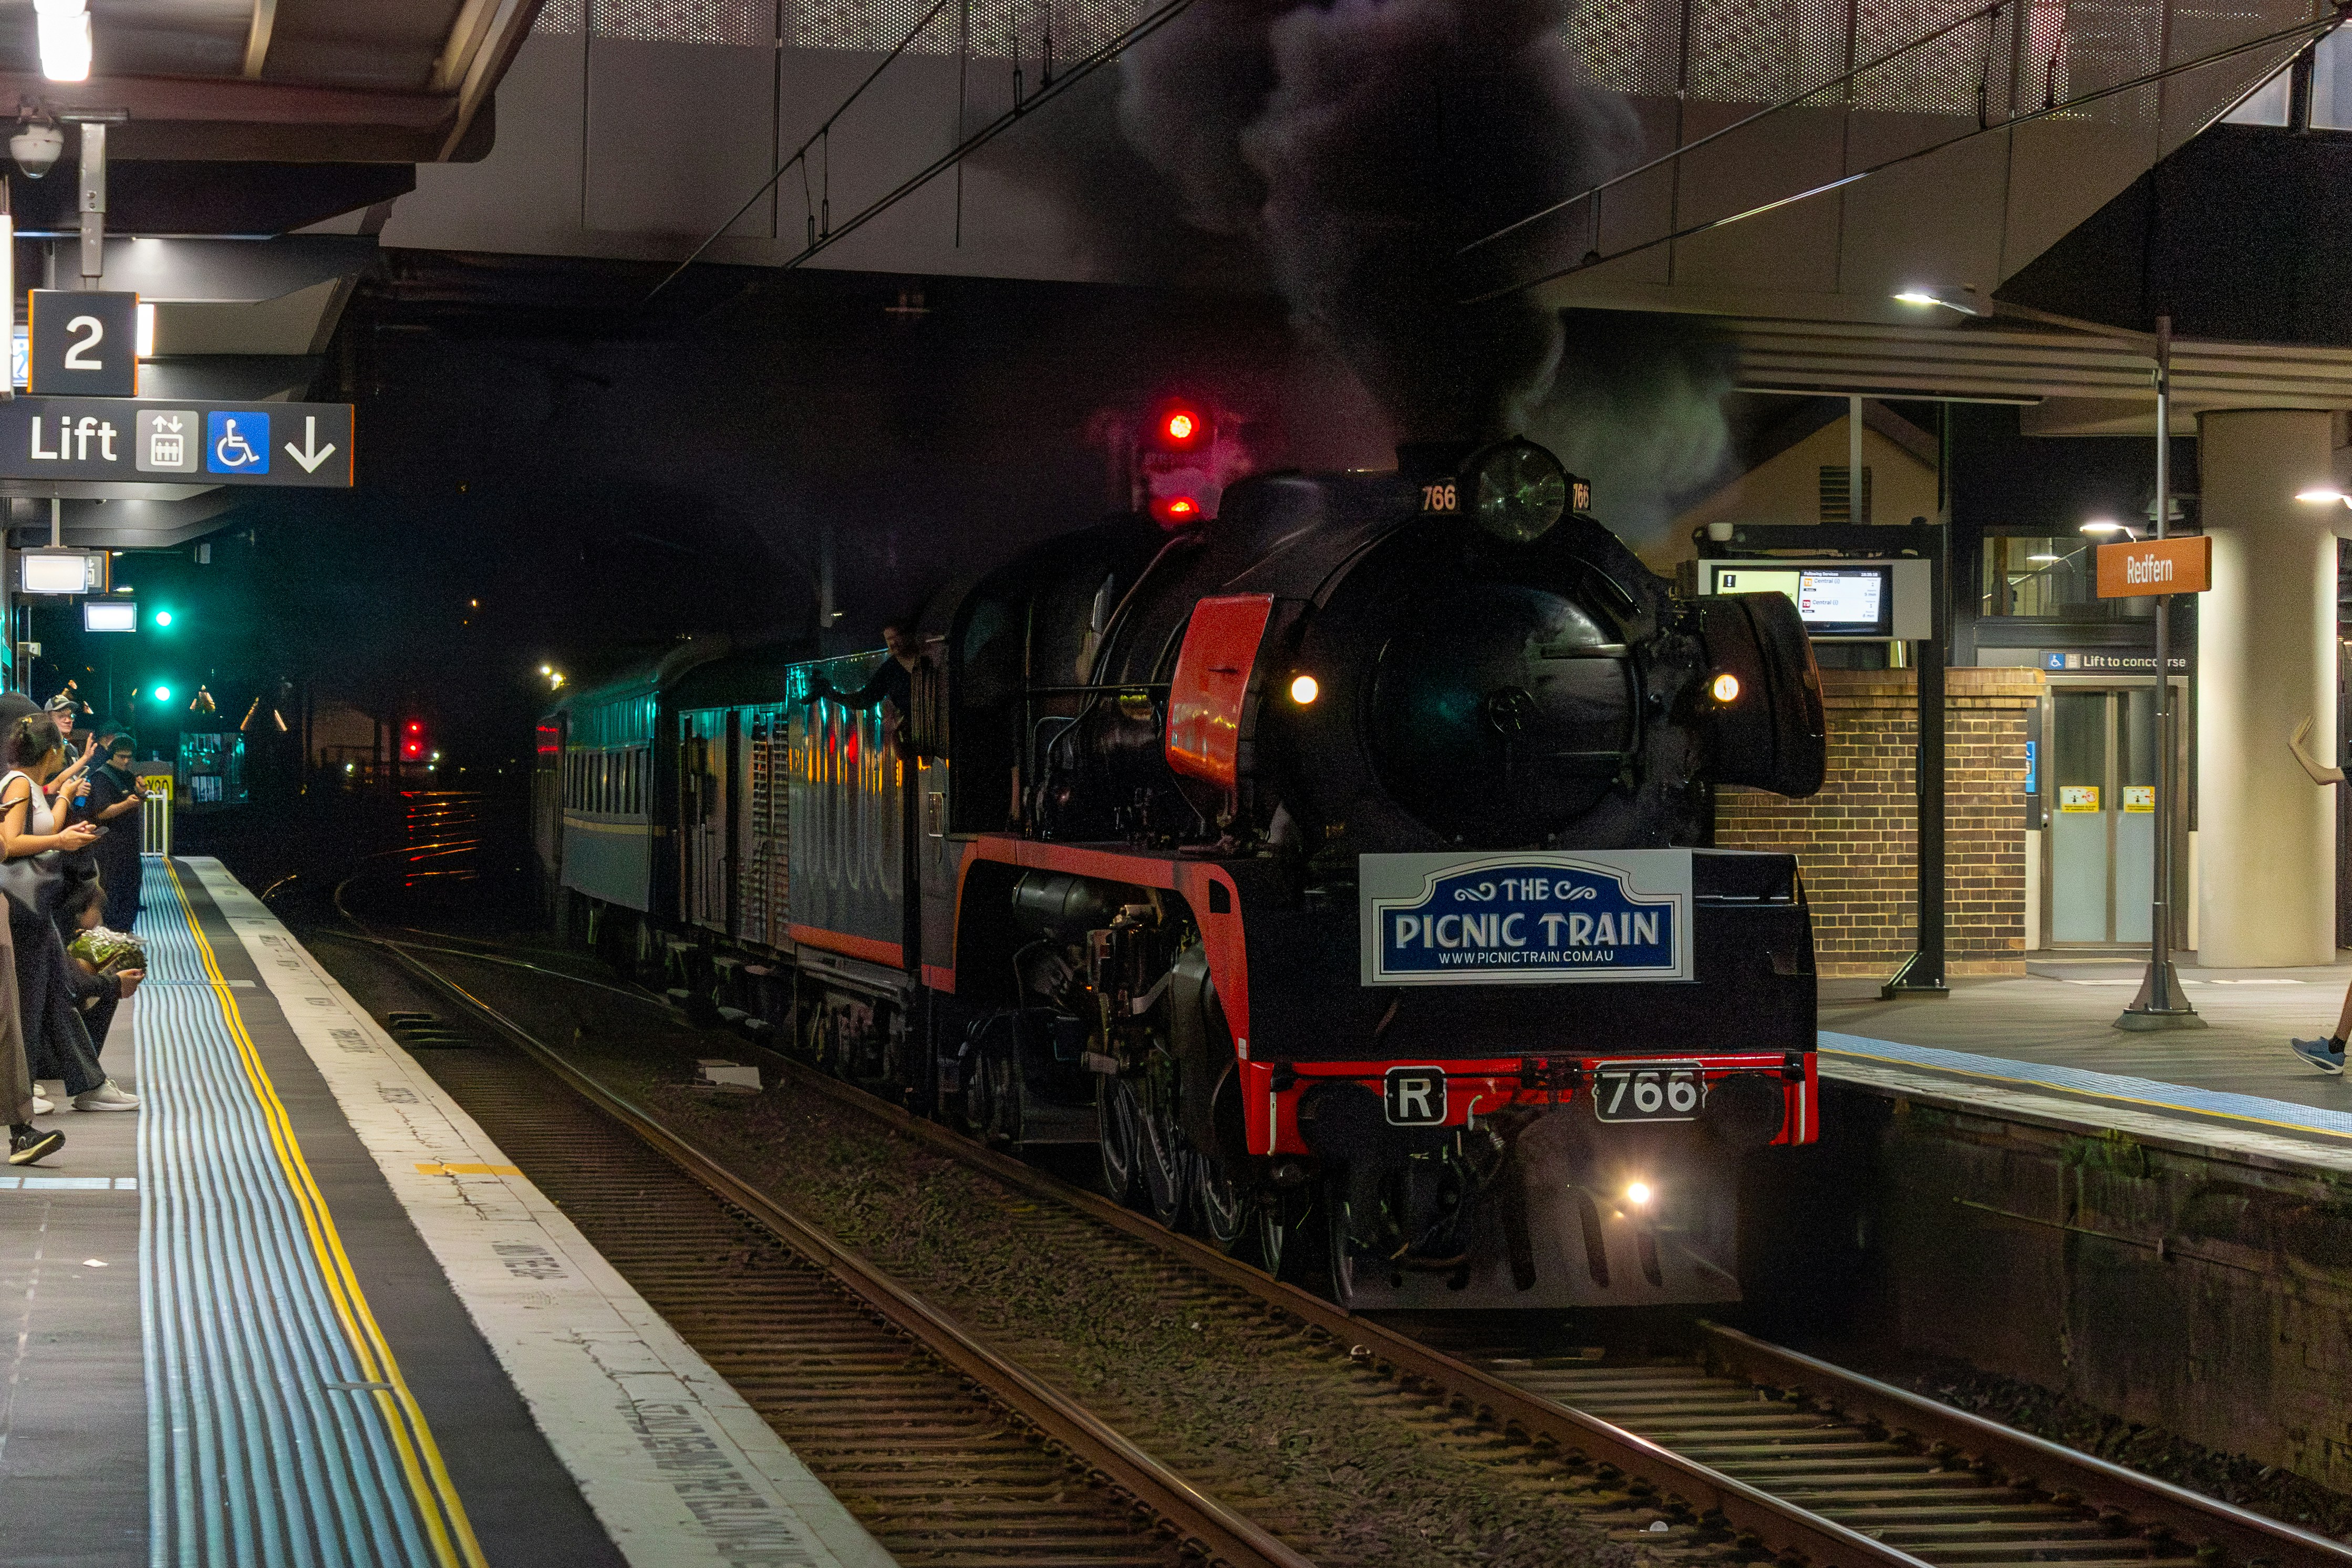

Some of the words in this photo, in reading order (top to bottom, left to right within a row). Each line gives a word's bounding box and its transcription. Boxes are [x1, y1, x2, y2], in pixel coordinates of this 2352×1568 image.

[65, 315, 103, 370] 2
[31, 416, 117, 461] Lift
[1422, 485, 1456, 511] 766
[1573, 483, 1589, 508] 766
[2127, 553, 2173, 584] Redfern
[2084, 655, 2105, 667] Lift
[2107, 657, 2120, 667] to
[2122, 658, 2186, 667] concorse
[1499, 878, 1549, 901] THE
[1395, 911, 1527, 949] PICNIC
[1537, 911, 1659, 947] TRAIN
[1438, 950, 1614, 964] WWW.PICNICTRAIN.COM.AU
[1398, 1078, 1433, 1118] R
[1601, 1071, 1697, 1114] 766
